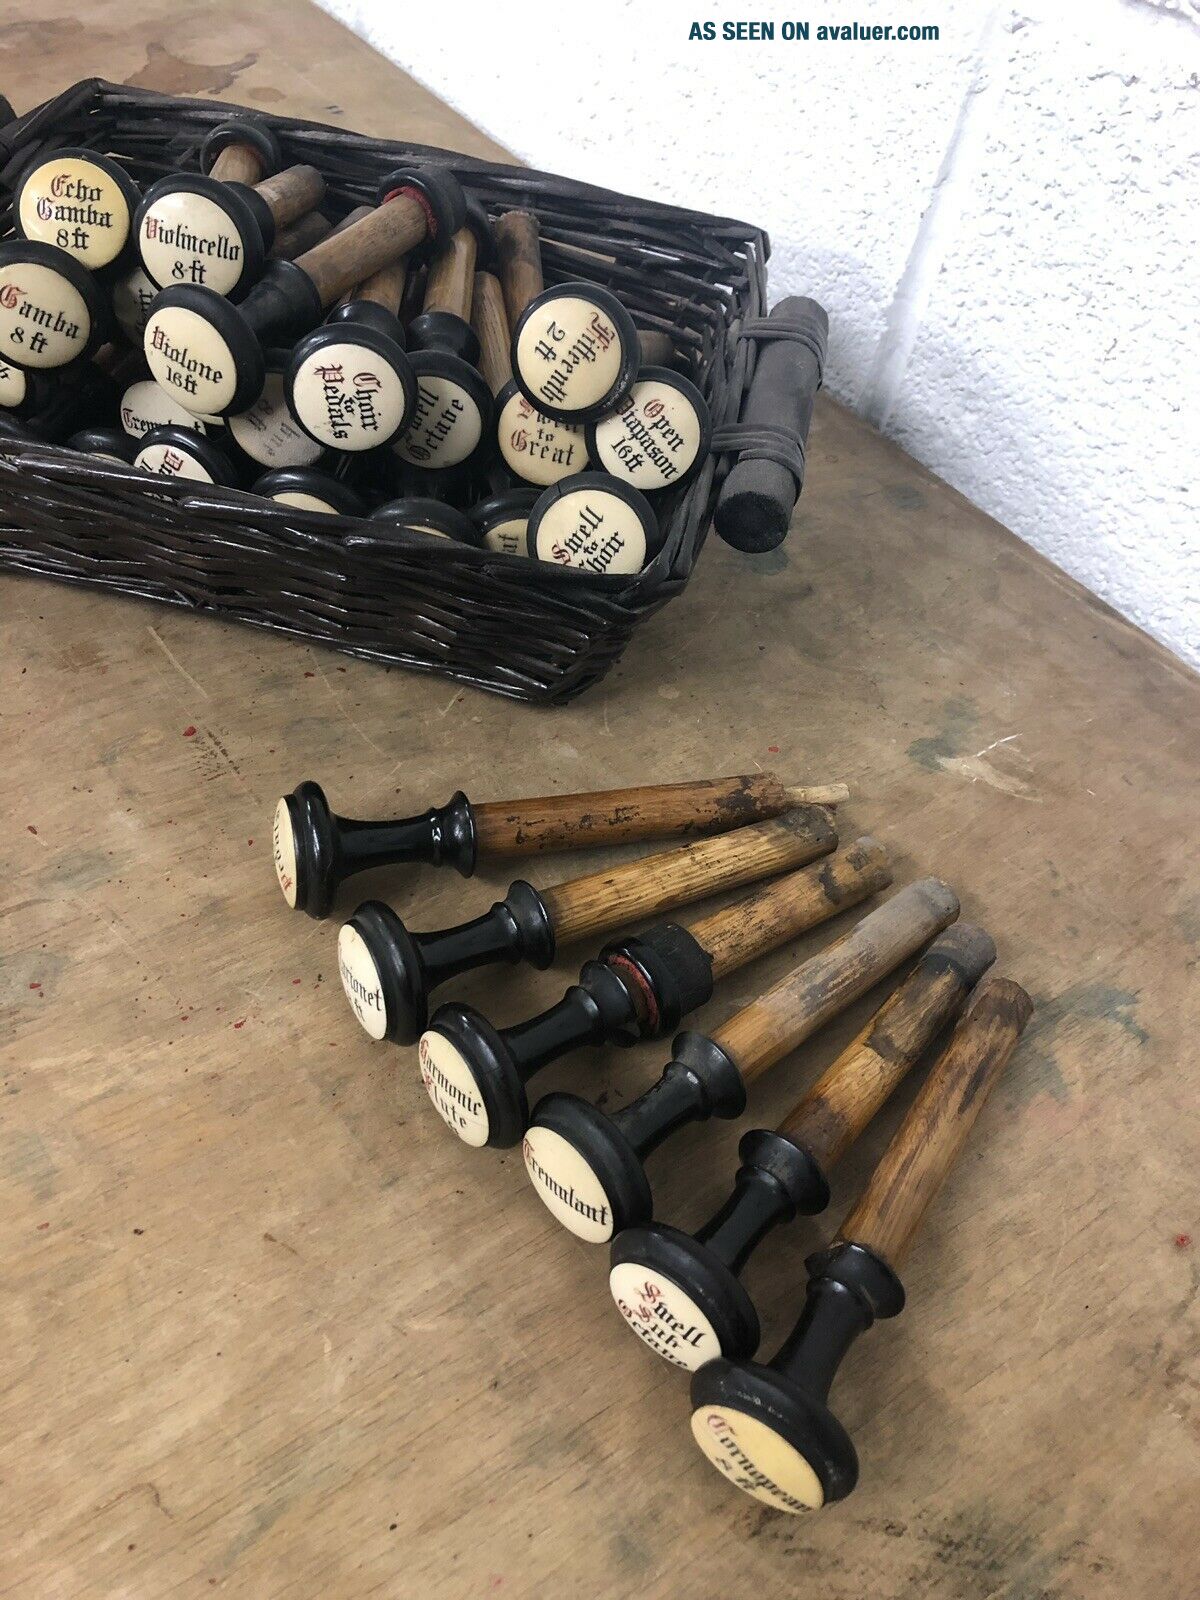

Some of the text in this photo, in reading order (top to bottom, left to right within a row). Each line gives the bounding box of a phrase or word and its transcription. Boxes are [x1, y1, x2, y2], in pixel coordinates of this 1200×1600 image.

[36, 196, 114, 229] Gamba
[50, 174, 103, 203] Echo
[145, 215, 241, 261] Violincello
[0, 283, 80, 340] Gamba
[150, 325, 223, 385] Violone
[540, 311, 615, 403] Fifteenth
[313, 363, 352, 440] Pedals
[352, 372, 383, 431] Choir
[407, 399, 464, 460] Octave
[644, 399, 685, 452] Open
[511, 429, 574, 466] Great
[537, 428, 555, 442] to
[552, 505, 603, 565] Swell
[579, 531, 625, 573] hoir
[583, 541, 598, 554] to
[523, 1138, 608, 1225] Tremulant
[636, 1281, 706, 1348] Swell
